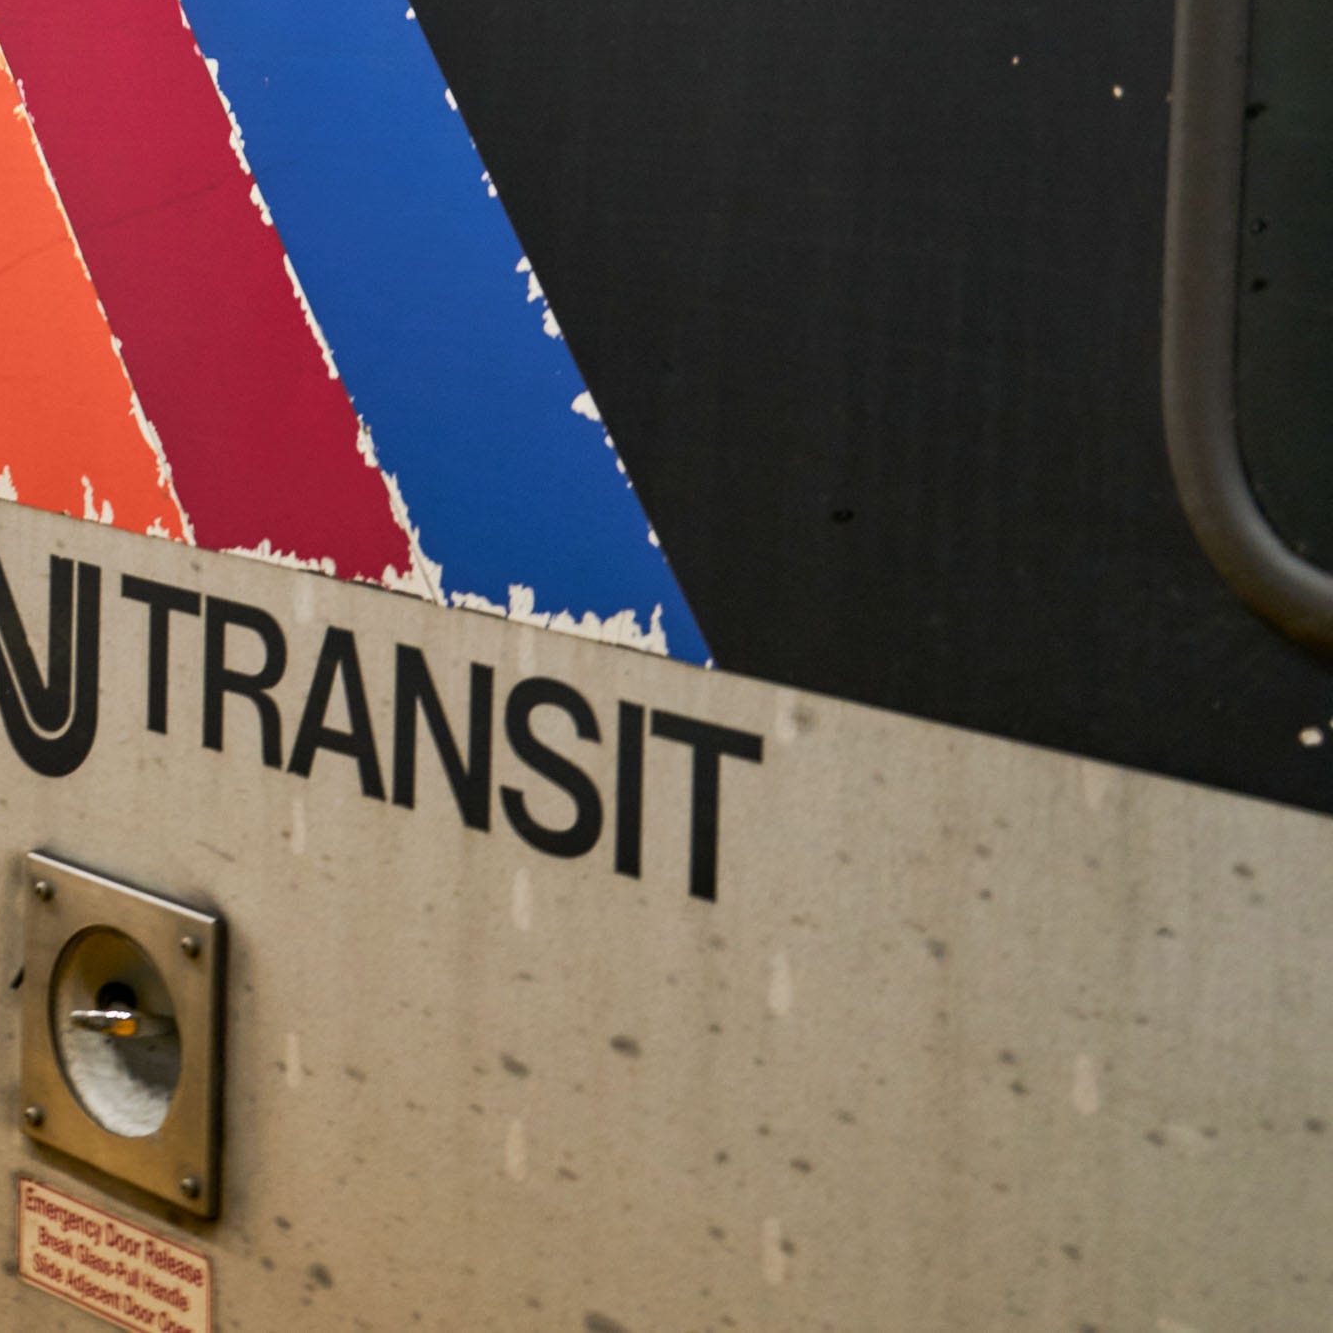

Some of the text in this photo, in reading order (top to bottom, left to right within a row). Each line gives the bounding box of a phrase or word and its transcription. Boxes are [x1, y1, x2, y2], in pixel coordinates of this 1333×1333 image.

[121, 573, 765, 902] TRANSIT
[25, 1187, 204, 1287] Emergency Door Release
[38, 1226, 74, 1258] Break
[142, 1274, 190, 1312] Handle
[33, 1252, 63, 1282] Slide
[65, 1269, 121, 1309] Adjacent
[123, 1294, 157, 1325] Door
